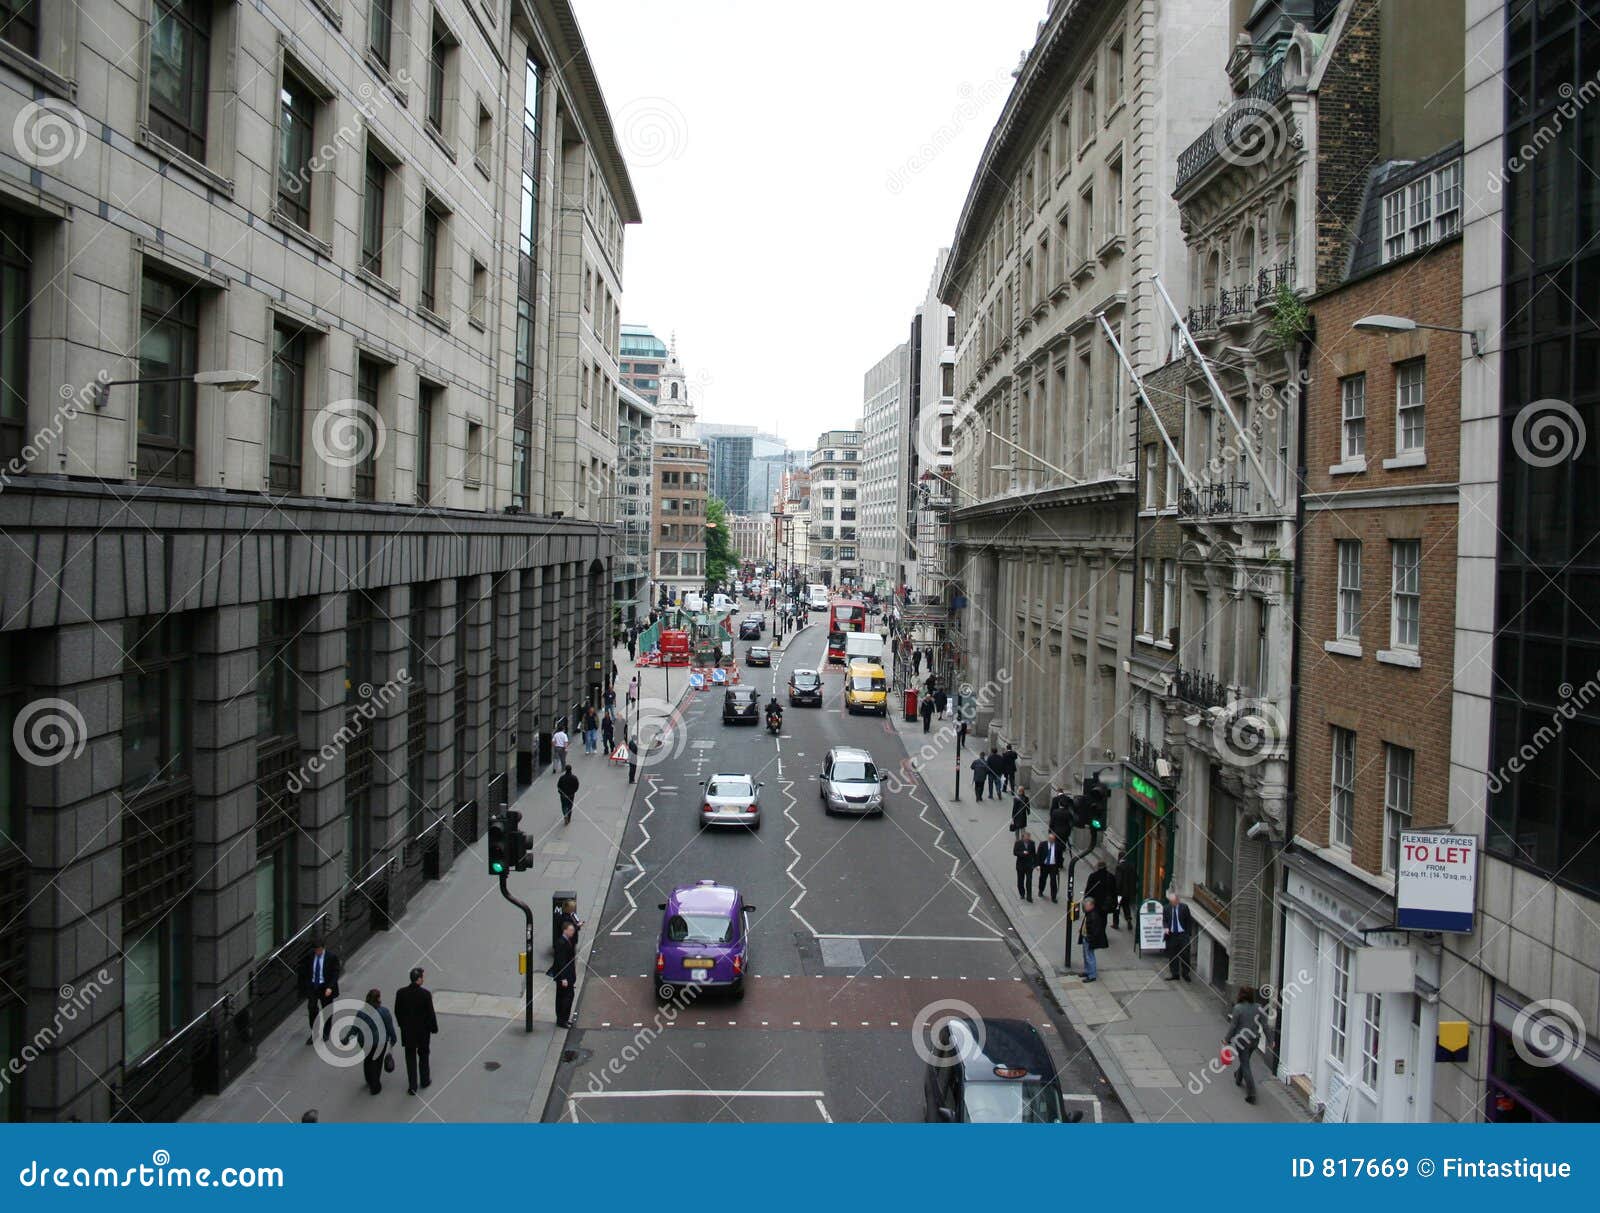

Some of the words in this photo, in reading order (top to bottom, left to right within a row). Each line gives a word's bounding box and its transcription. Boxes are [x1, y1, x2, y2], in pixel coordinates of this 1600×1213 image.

[1402, 835, 1438, 844] FLEXIBLE
[1440, 837, 1473, 847] OFFICES
[1404, 845, 1429, 862] TO
[1435, 846, 1471, 864] LET
[1426, 864, 1446, 872] FROM
